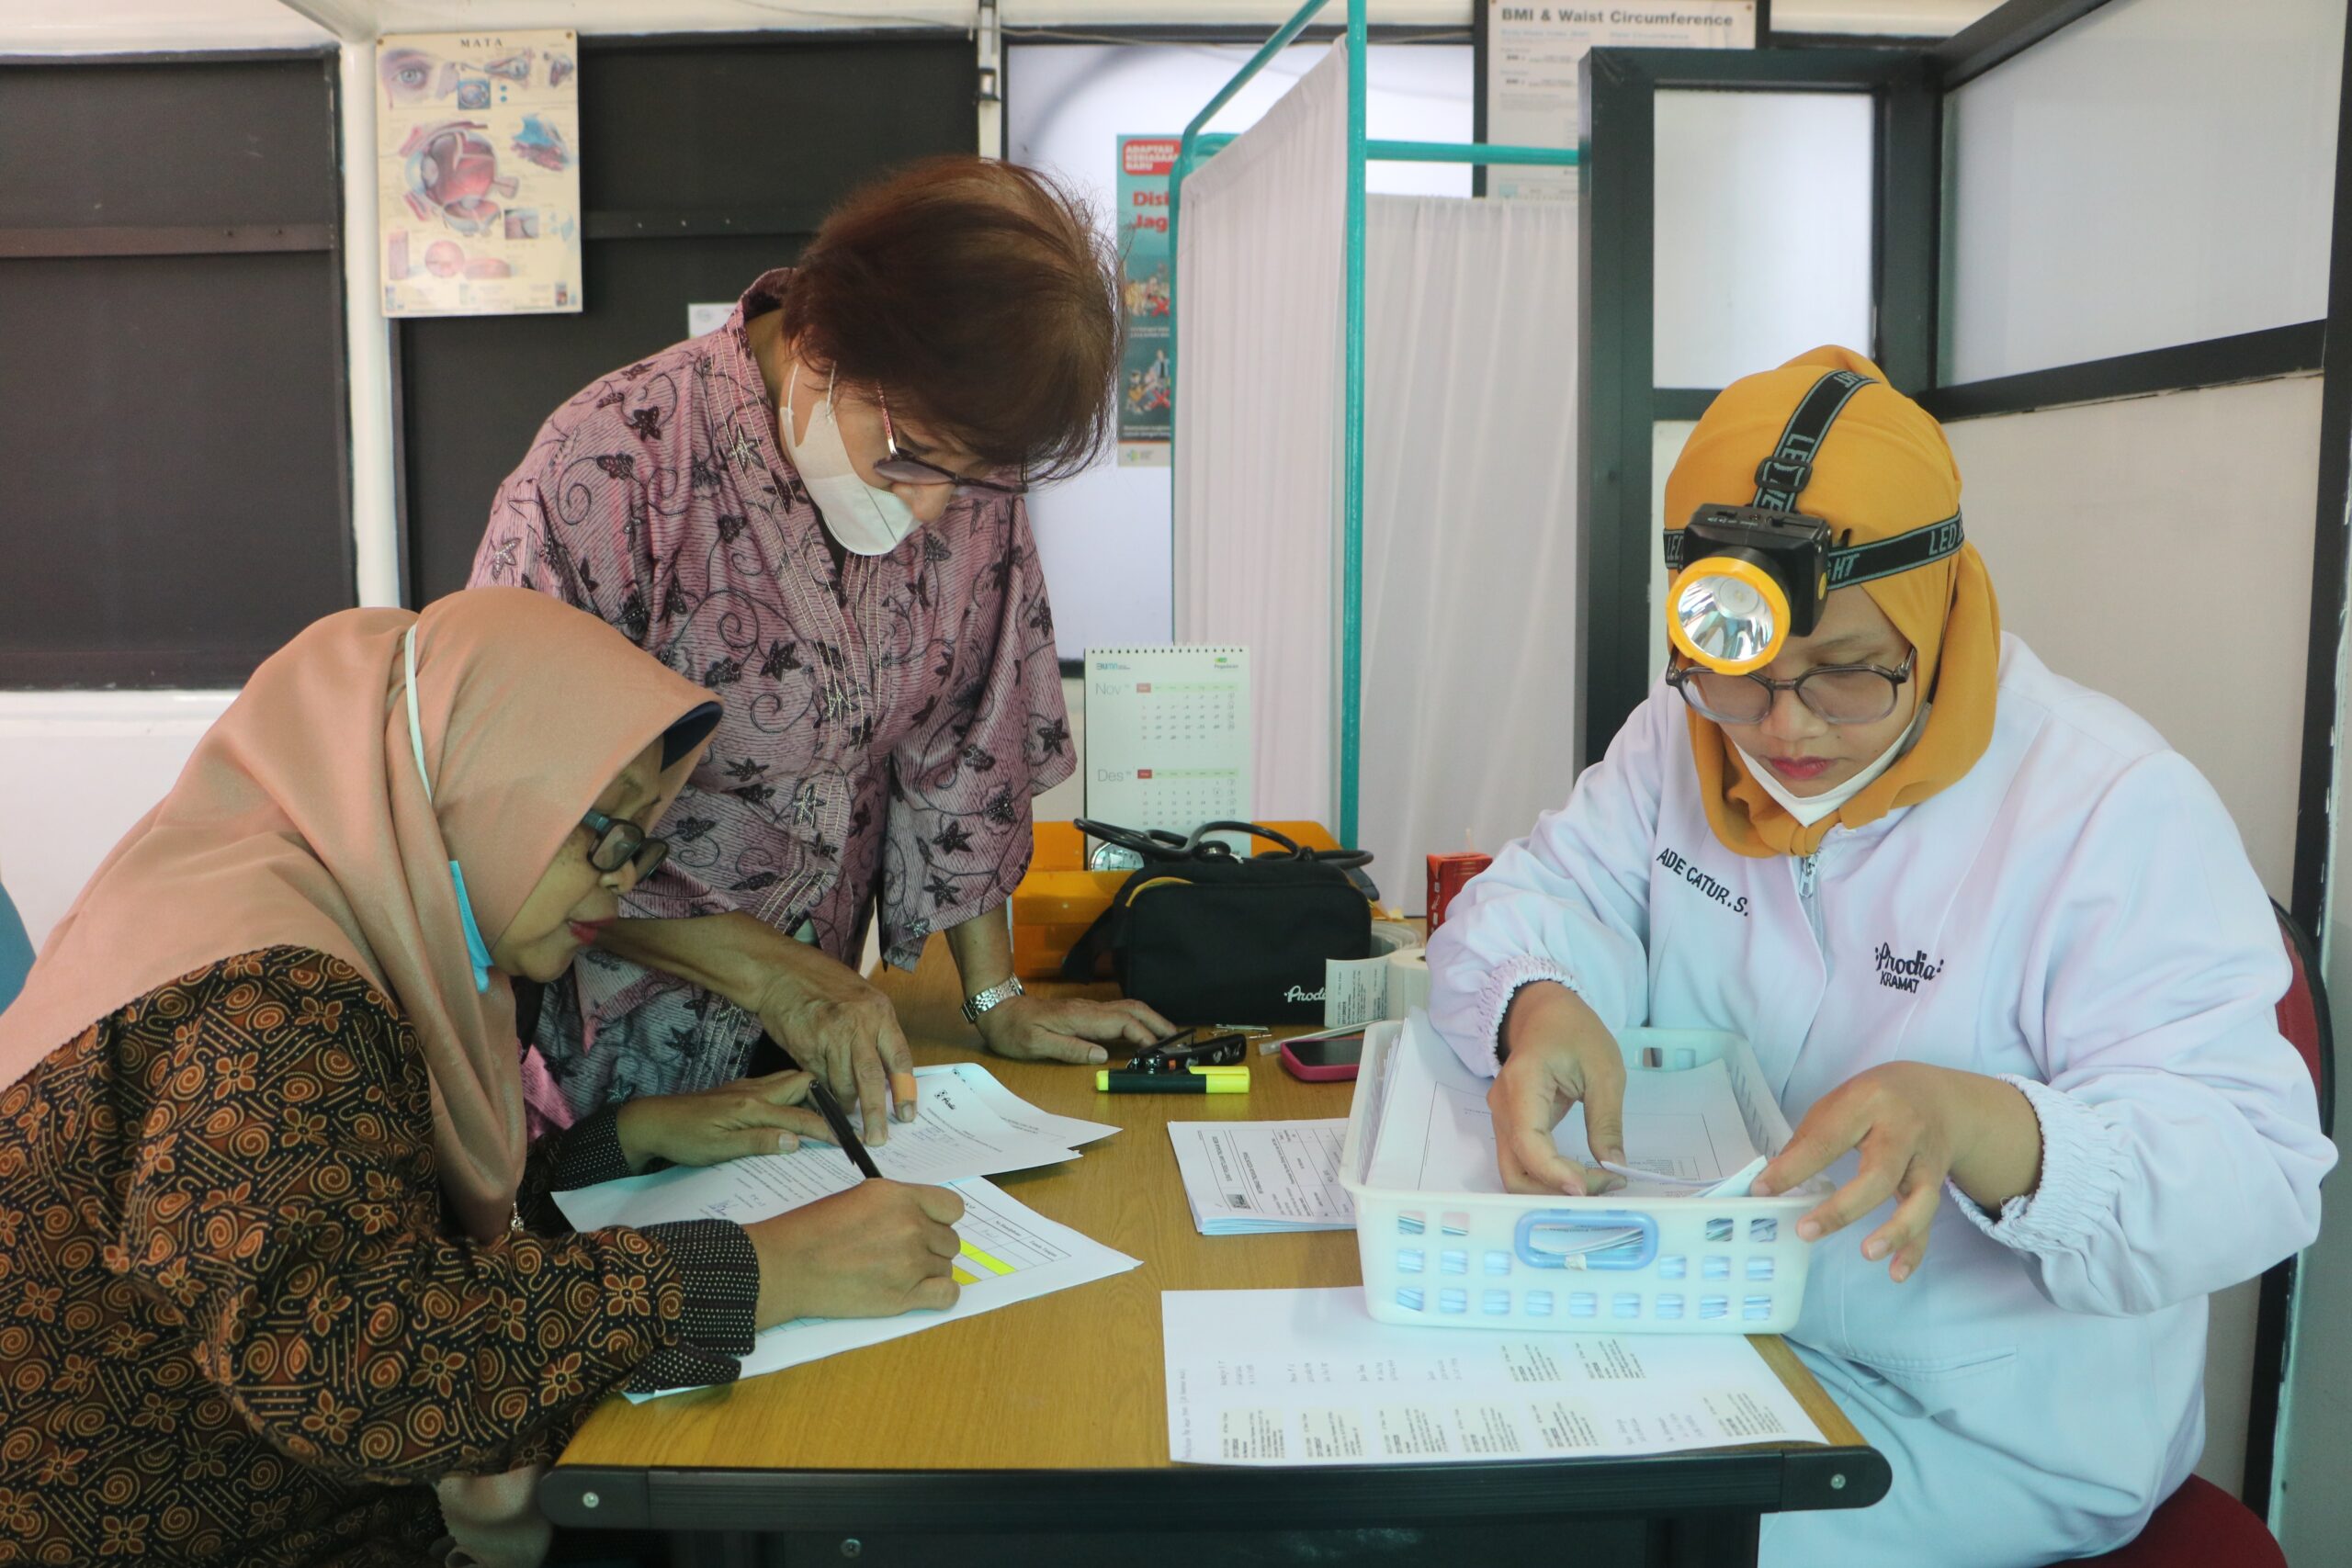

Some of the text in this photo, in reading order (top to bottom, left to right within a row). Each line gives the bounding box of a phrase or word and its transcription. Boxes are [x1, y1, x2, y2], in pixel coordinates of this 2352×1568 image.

[1501, 7, 1734, 27] BMI & Waist Circumference
[460, 38, 503, 48] MATA
[1928, 522, 1958, 557] LED
[1095, 682, 1121, 695] Nov
[1097, 769, 1125, 782] Des
[1656, 848, 1687, 876] ADE
[1875, 942, 1944, 981] Prodia
[1880, 970, 1920, 994] KRAMAT
